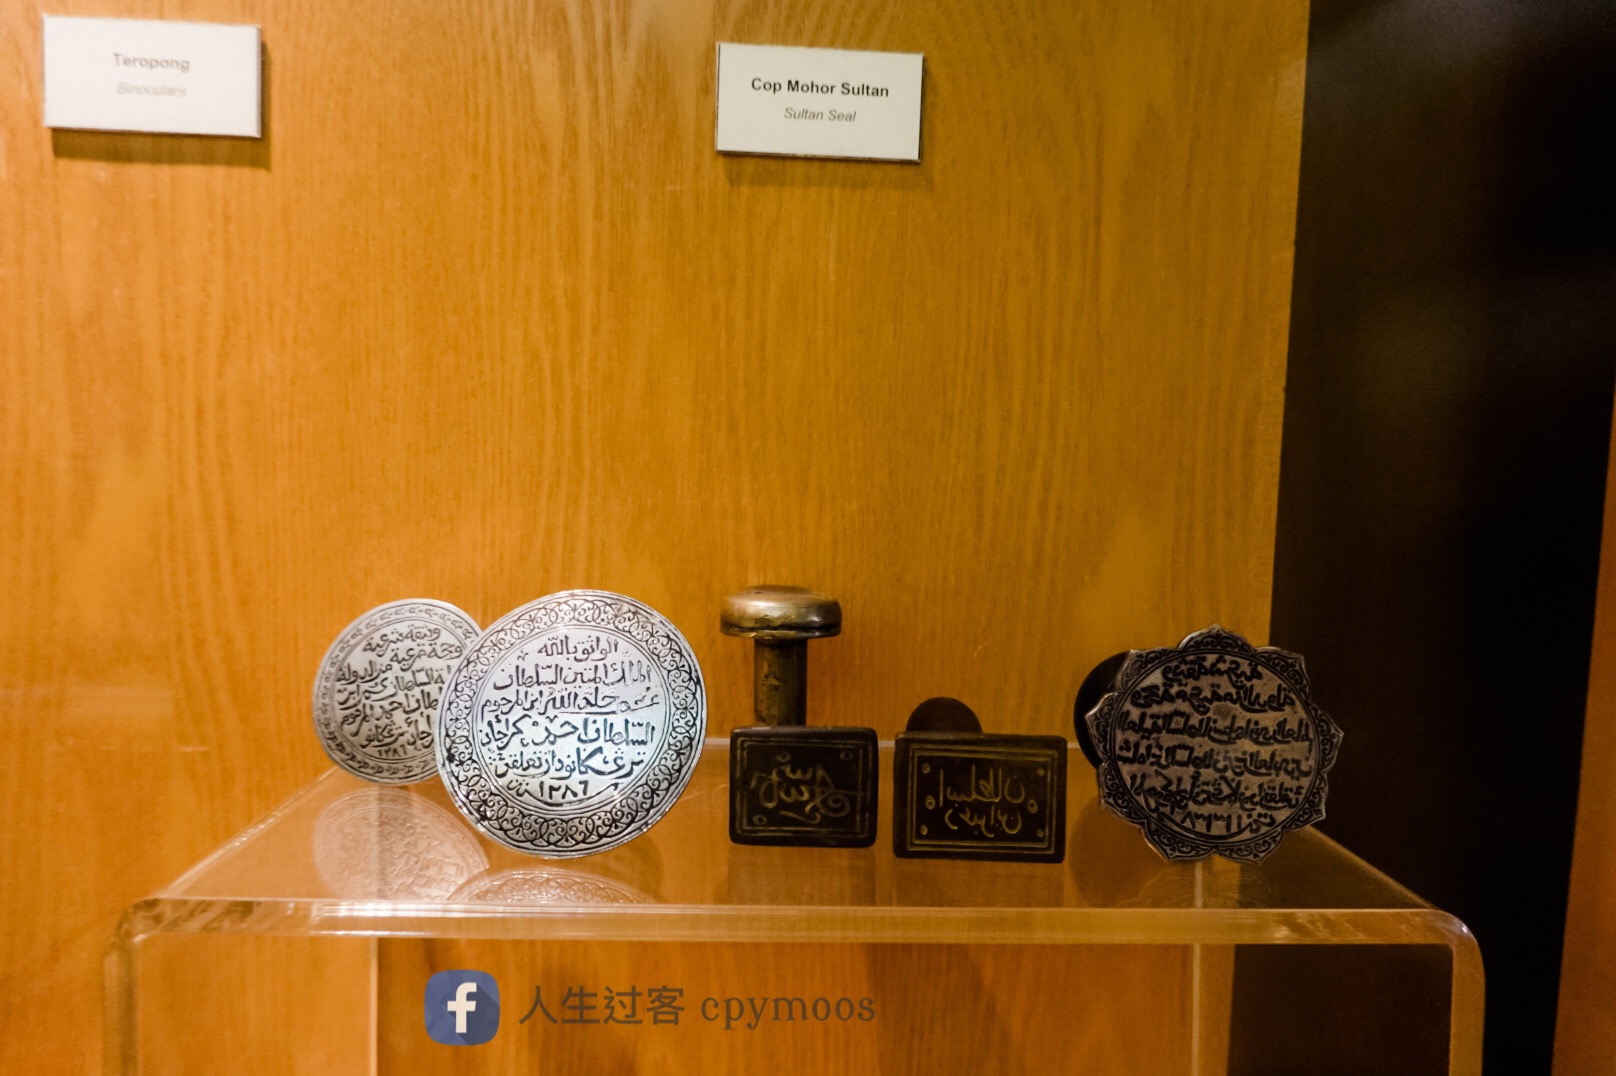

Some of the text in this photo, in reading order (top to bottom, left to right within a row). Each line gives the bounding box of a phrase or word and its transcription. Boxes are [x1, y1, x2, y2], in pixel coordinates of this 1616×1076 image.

[112, 52, 191, 73] Teropong
[751, 77, 889, 98] Cop Mohor Sultan
[784, 107, 857, 122] Sultan Seal
